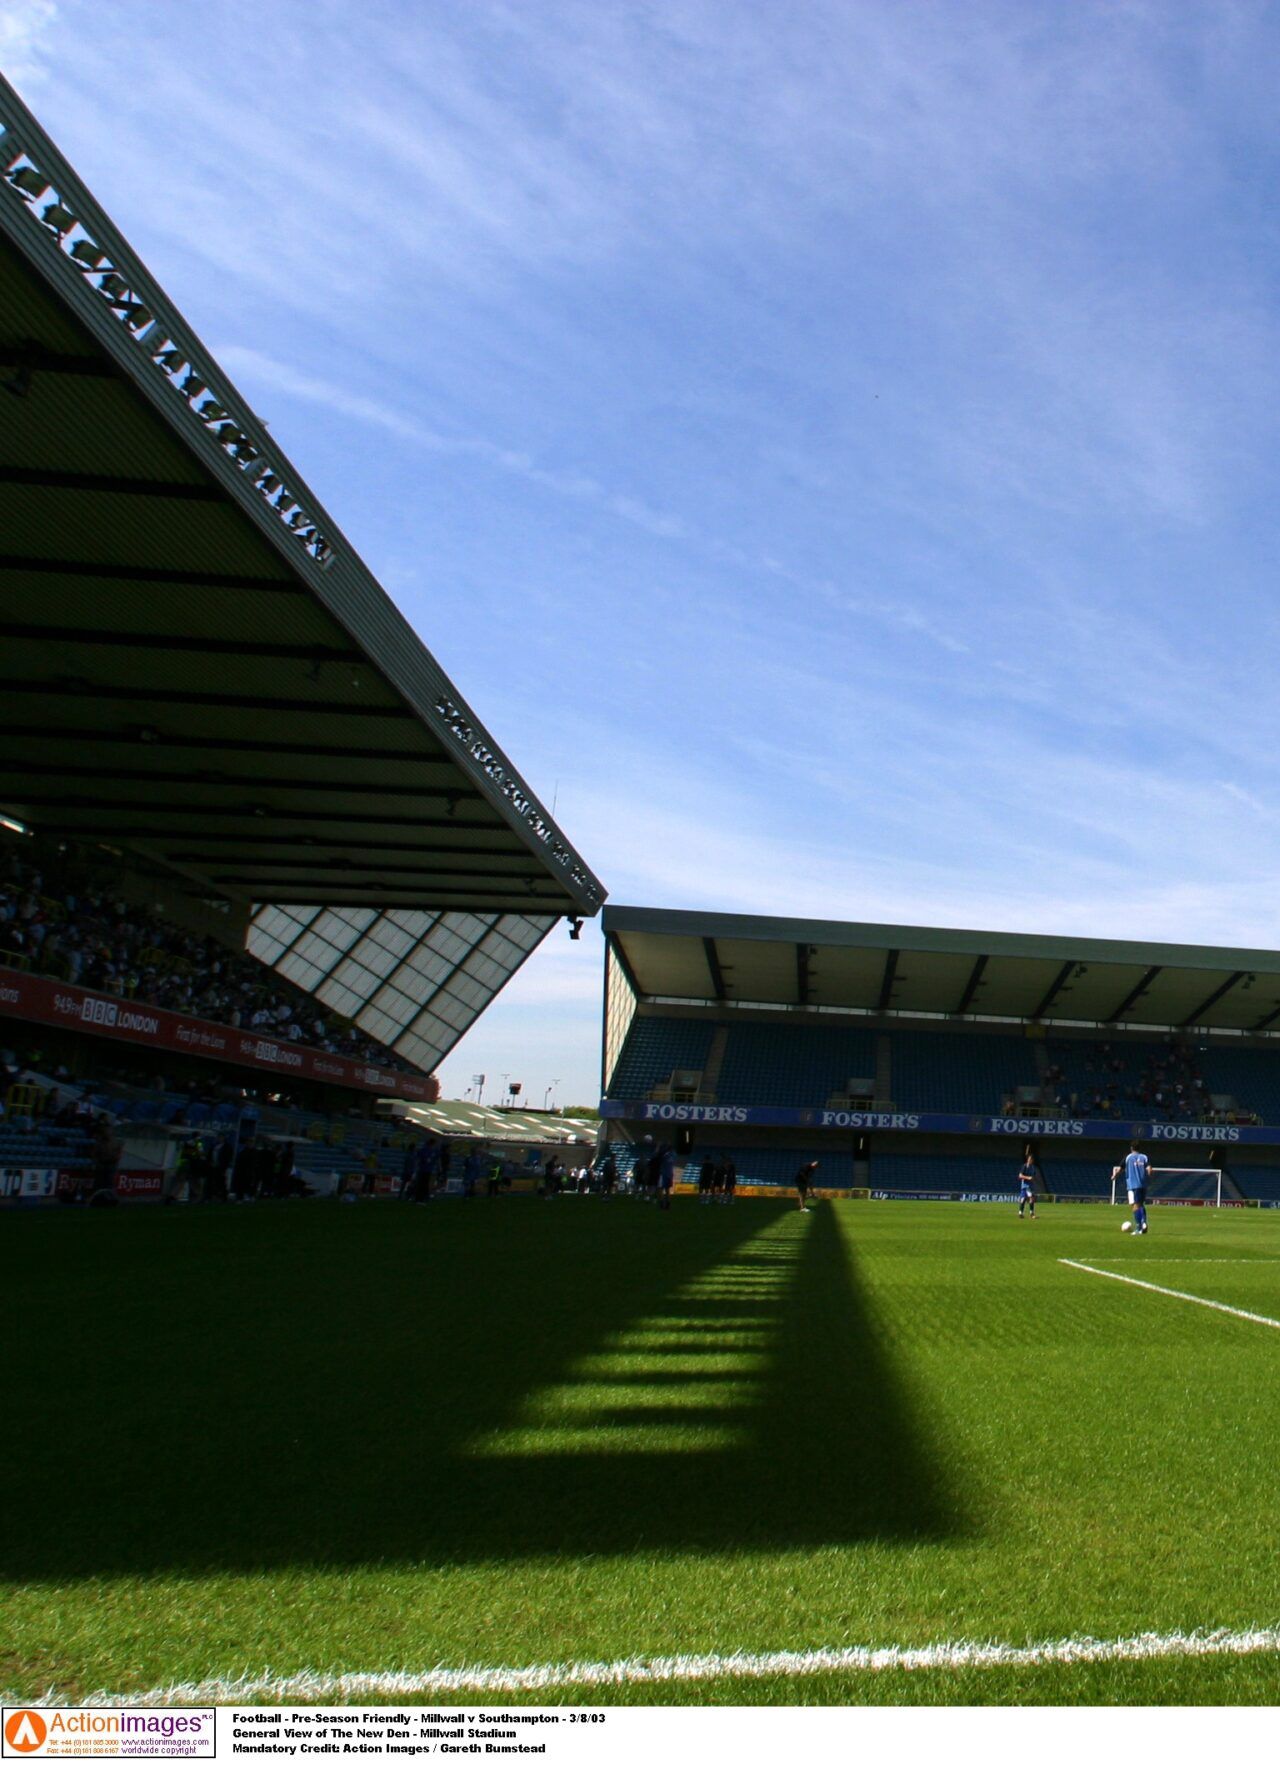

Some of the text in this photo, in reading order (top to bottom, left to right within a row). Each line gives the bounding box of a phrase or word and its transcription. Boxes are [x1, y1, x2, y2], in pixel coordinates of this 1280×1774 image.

[81, 997, 118, 1027] BBC
[118, 1011, 160, 1034] LONDON
[645, 1104, 748, 1121] FOSTER'S
[822, 1111, 920, 1129] FOSTER'S
[990, 1118, 1084, 1135] FOSTER'S
[1152, 1125, 1239, 1141] FOSTER'S
[117, 1174, 161, 1191] Ryman
[979, 1194, 1021, 1203] CLEANIN
